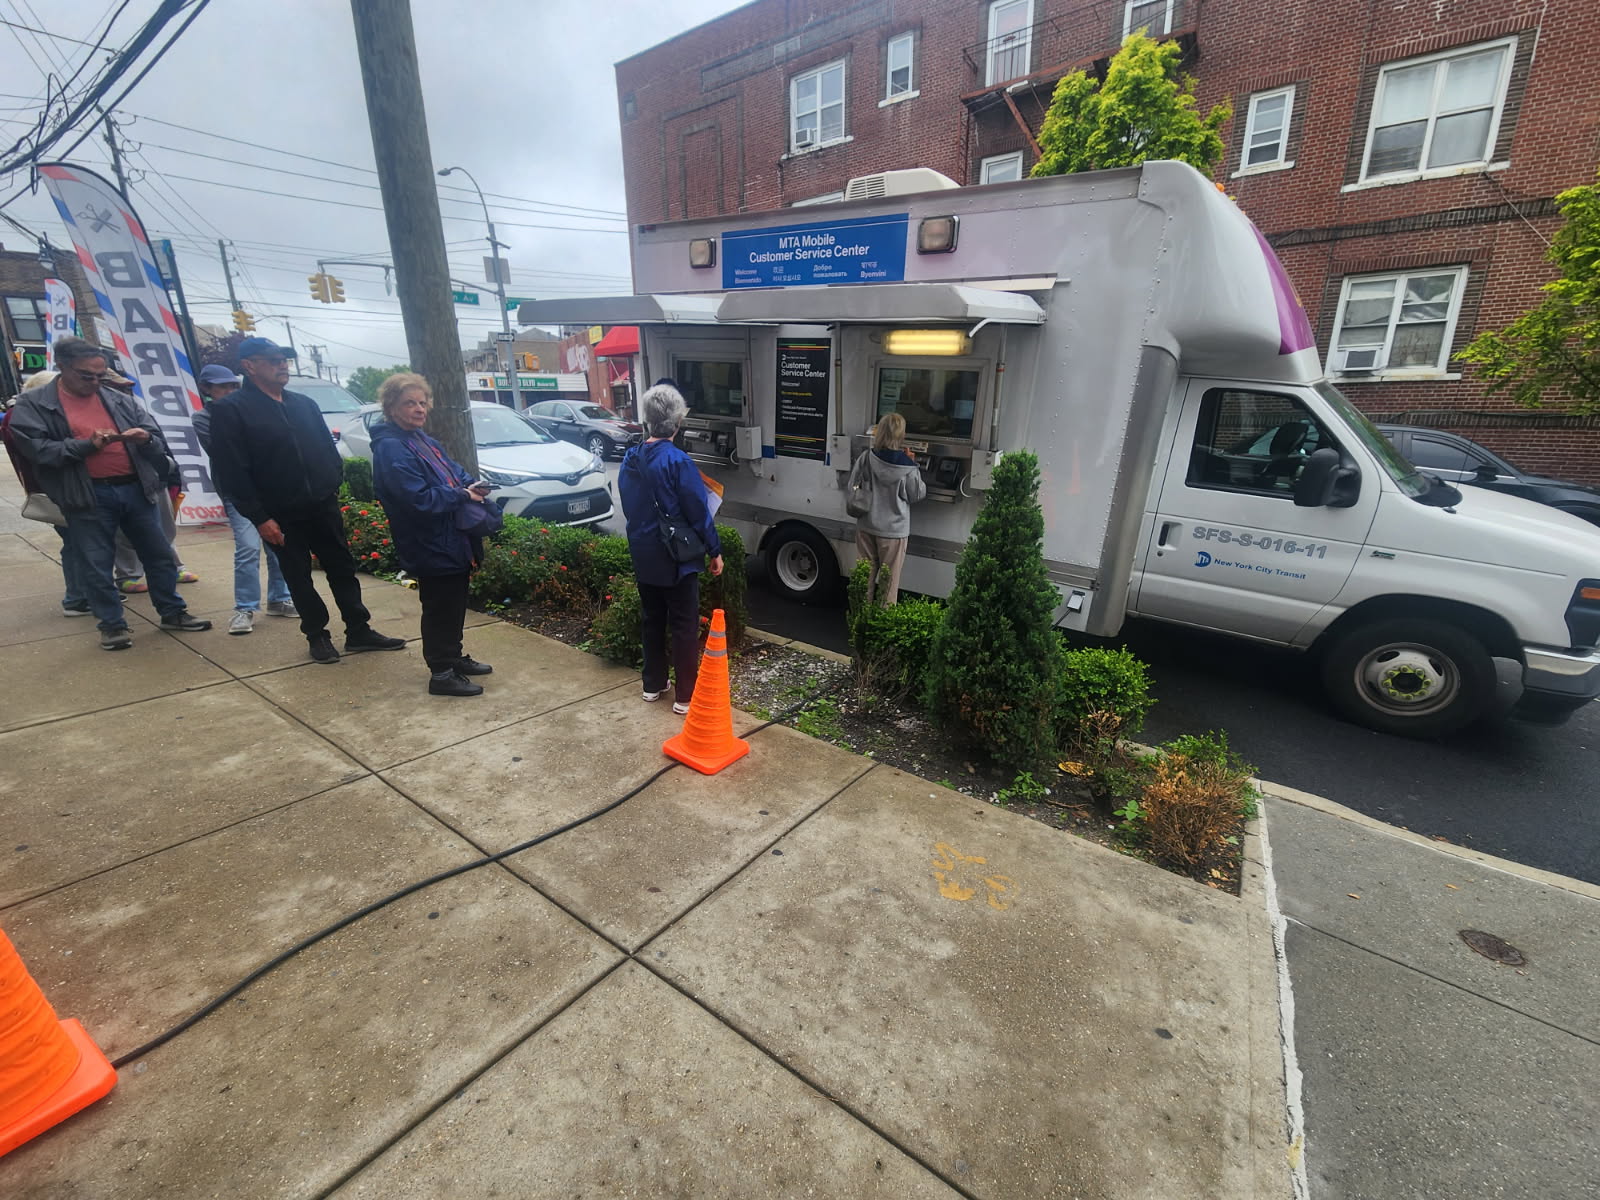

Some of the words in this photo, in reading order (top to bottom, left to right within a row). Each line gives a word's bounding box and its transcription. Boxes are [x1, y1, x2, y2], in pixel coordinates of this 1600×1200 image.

[779, 236, 800, 249] MTA
[802, 233, 835, 247] Mobile
[750, 251, 793, 263] Customer
[795, 247, 832, 260] Service
[834, 244, 870, 257] Center
[781, 361, 811, 370] Customer
[781, 369, 804, 377] Service
[805, 370, 826, 378] Center
[1193, 526, 1327, 559] SFS-S-016-11
[1214, 558, 1232, 567] New
[1235, 562, 1253, 571] York
[1255, 565, 1273, 575] City
[1276, 569, 1306, 580] Transit
